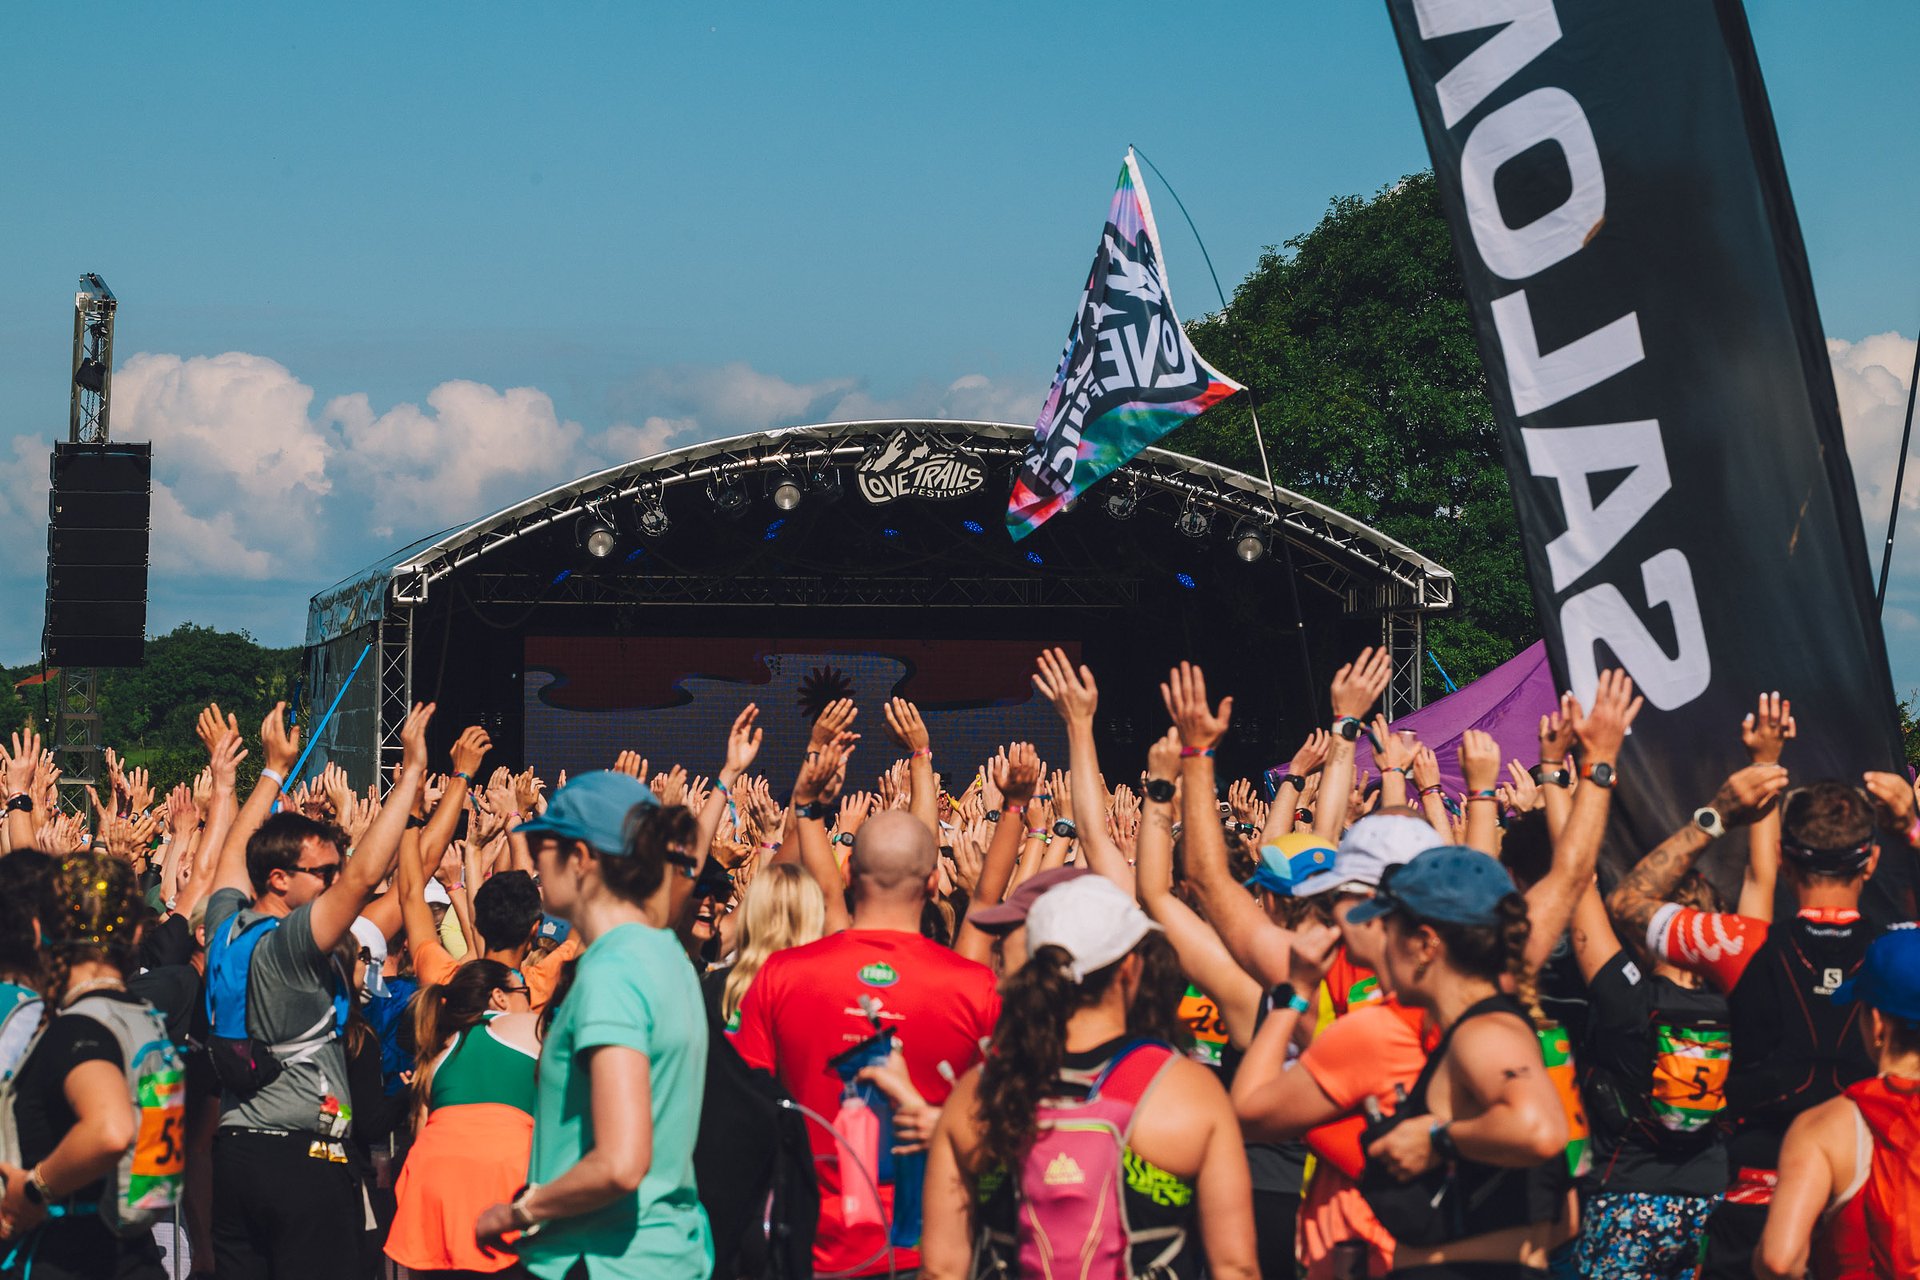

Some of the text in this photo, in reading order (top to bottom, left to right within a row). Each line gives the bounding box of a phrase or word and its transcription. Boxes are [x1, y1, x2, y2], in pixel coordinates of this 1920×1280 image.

[858, 471, 911, 503] LOVE
[909, 458, 984, 491] TRAILS
[910, 487, 970, 499] FESTIVAL
